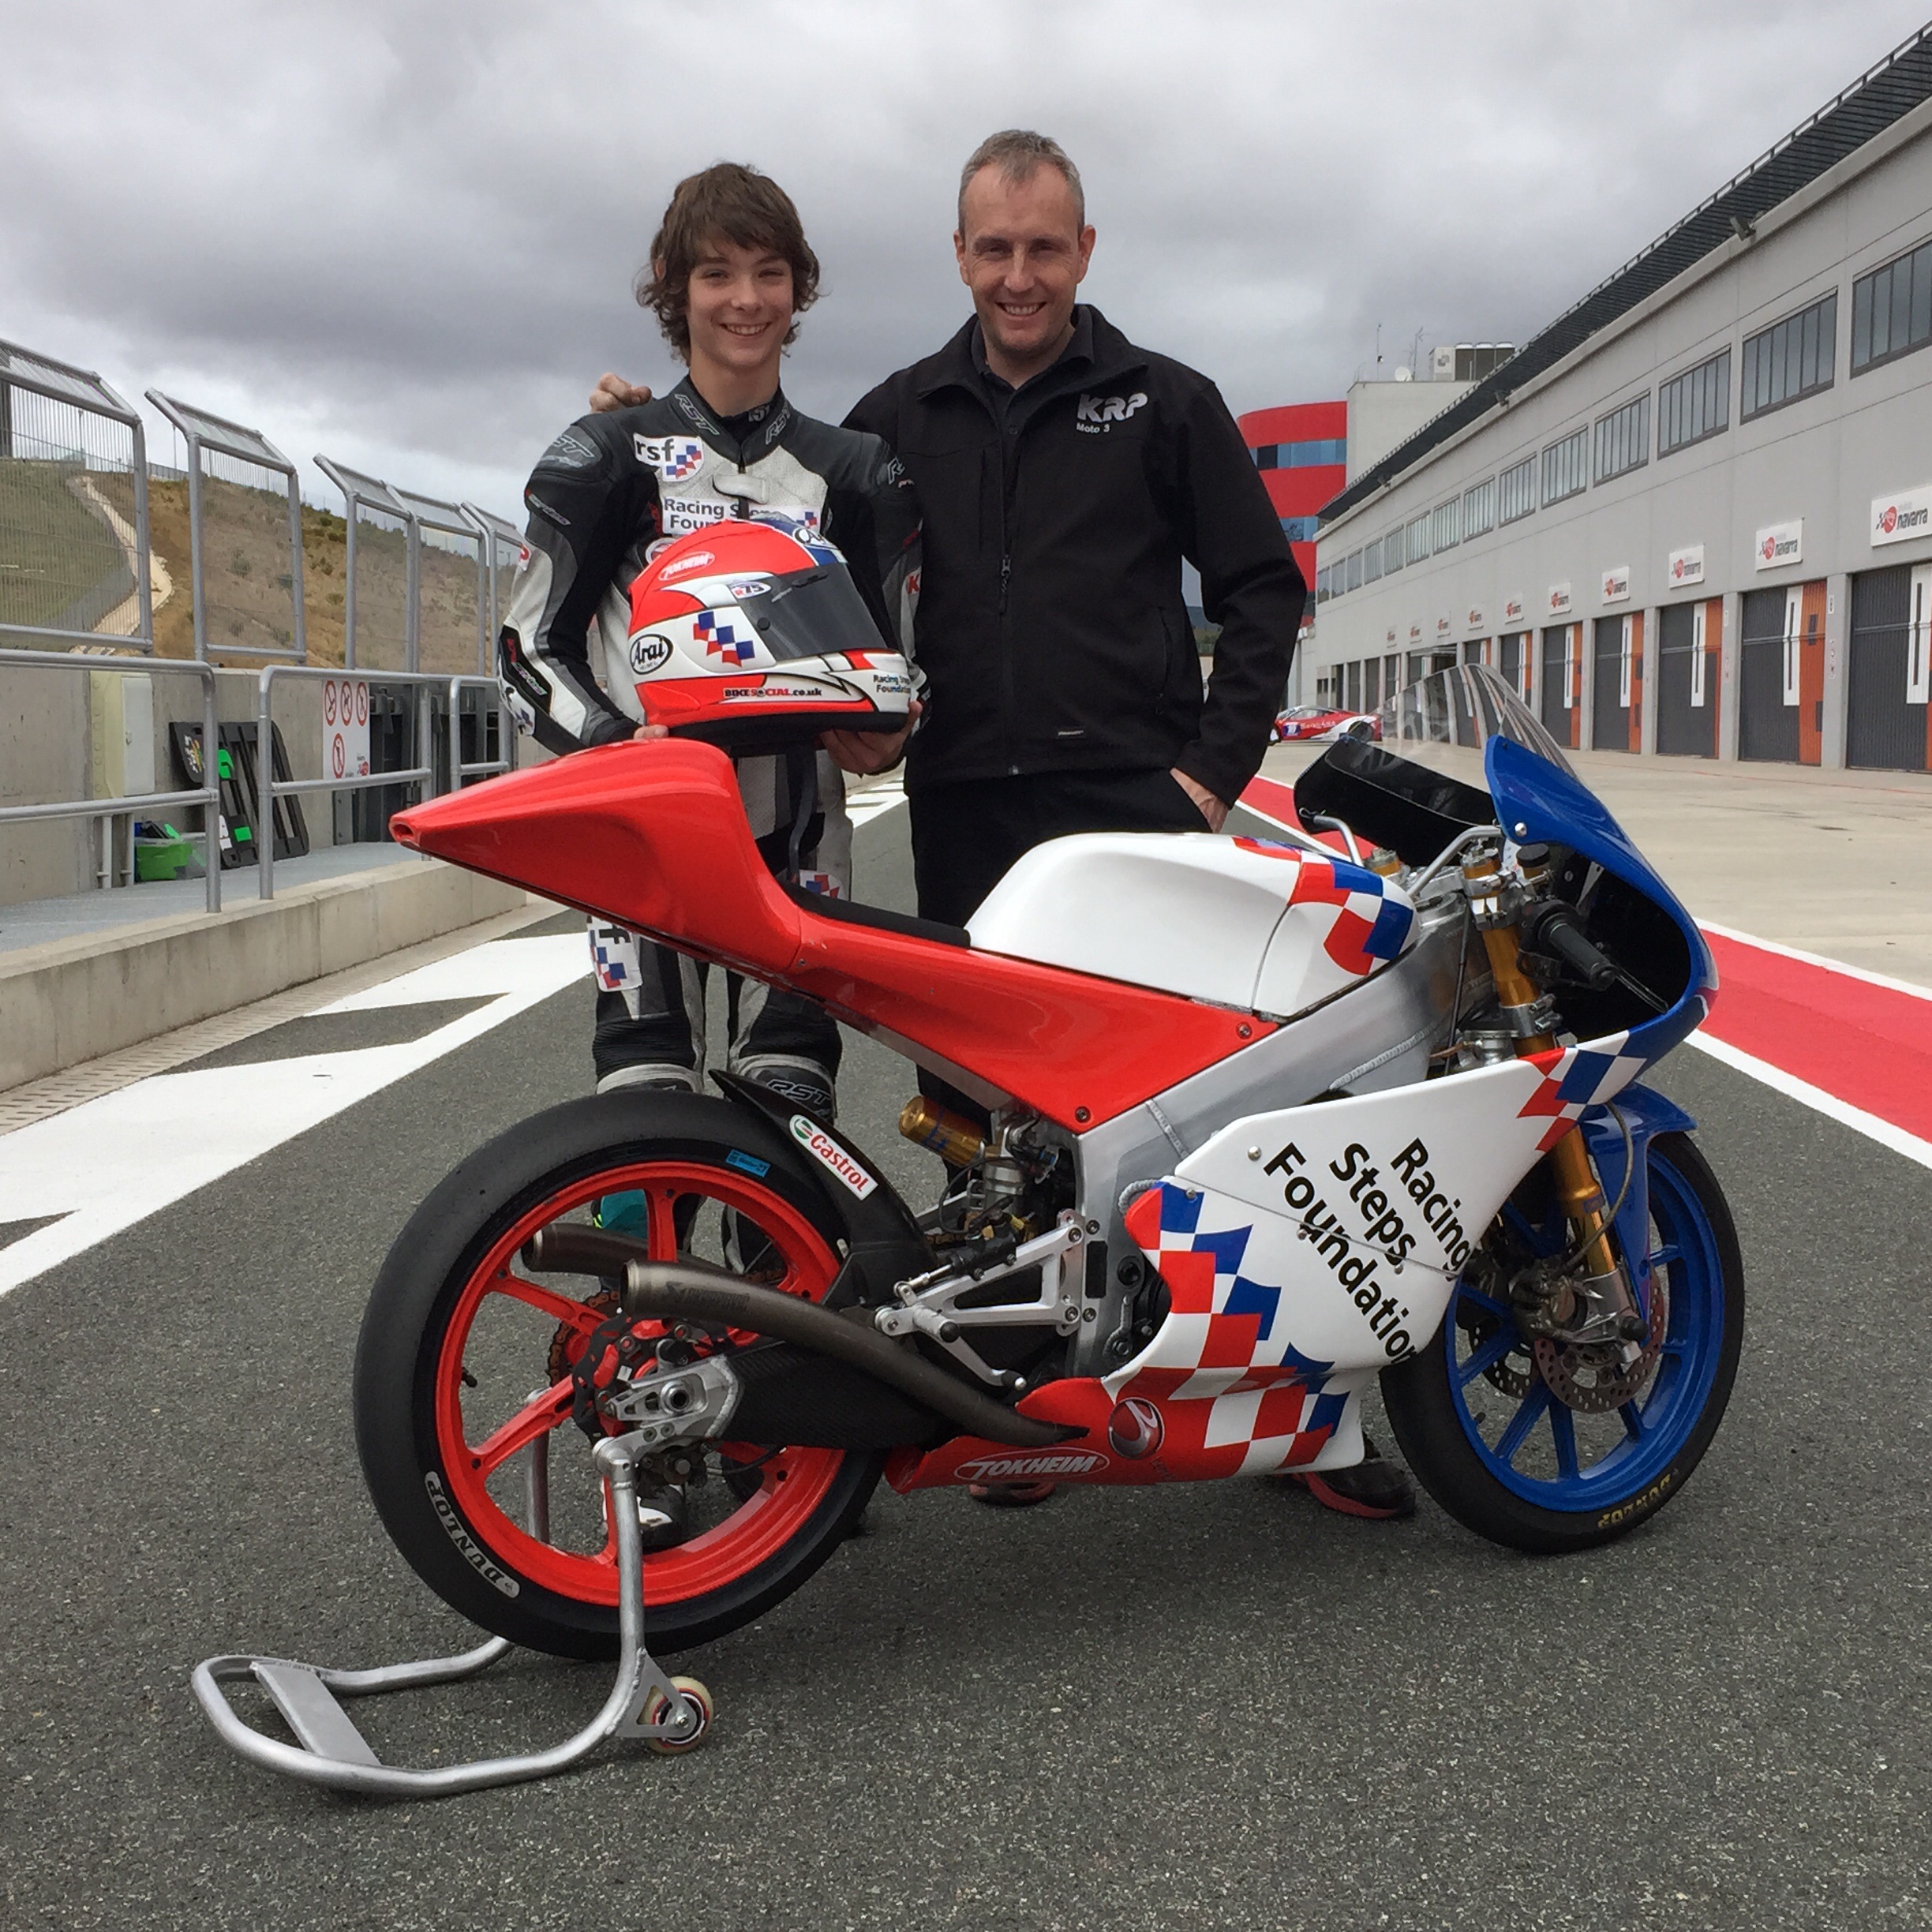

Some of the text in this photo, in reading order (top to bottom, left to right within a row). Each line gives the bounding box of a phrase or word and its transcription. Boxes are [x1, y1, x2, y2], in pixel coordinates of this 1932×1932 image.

[675, 394, 720, 435] RST
[1076, 393, 1148, 423] KRP
[1076, 422, 1110, 434] Moto 3
[635, 438, 675, 462] rsf
[664, 498, 724, 519] Racing
[1896, 507, 1928, 530] navarra
[632, 637, 665, 668] Arai
[766, 1078, 831, 1105] RST
[810, 1133, 869, 1193] Castrol
[1329, 1143, 1417, 1266] Steps
[1390, 1137, 1471, 1282] Racing
[961, 1455, 1099, 1481] TOKHEIM
[427, 1480, 505, 1584] DUNLOP
